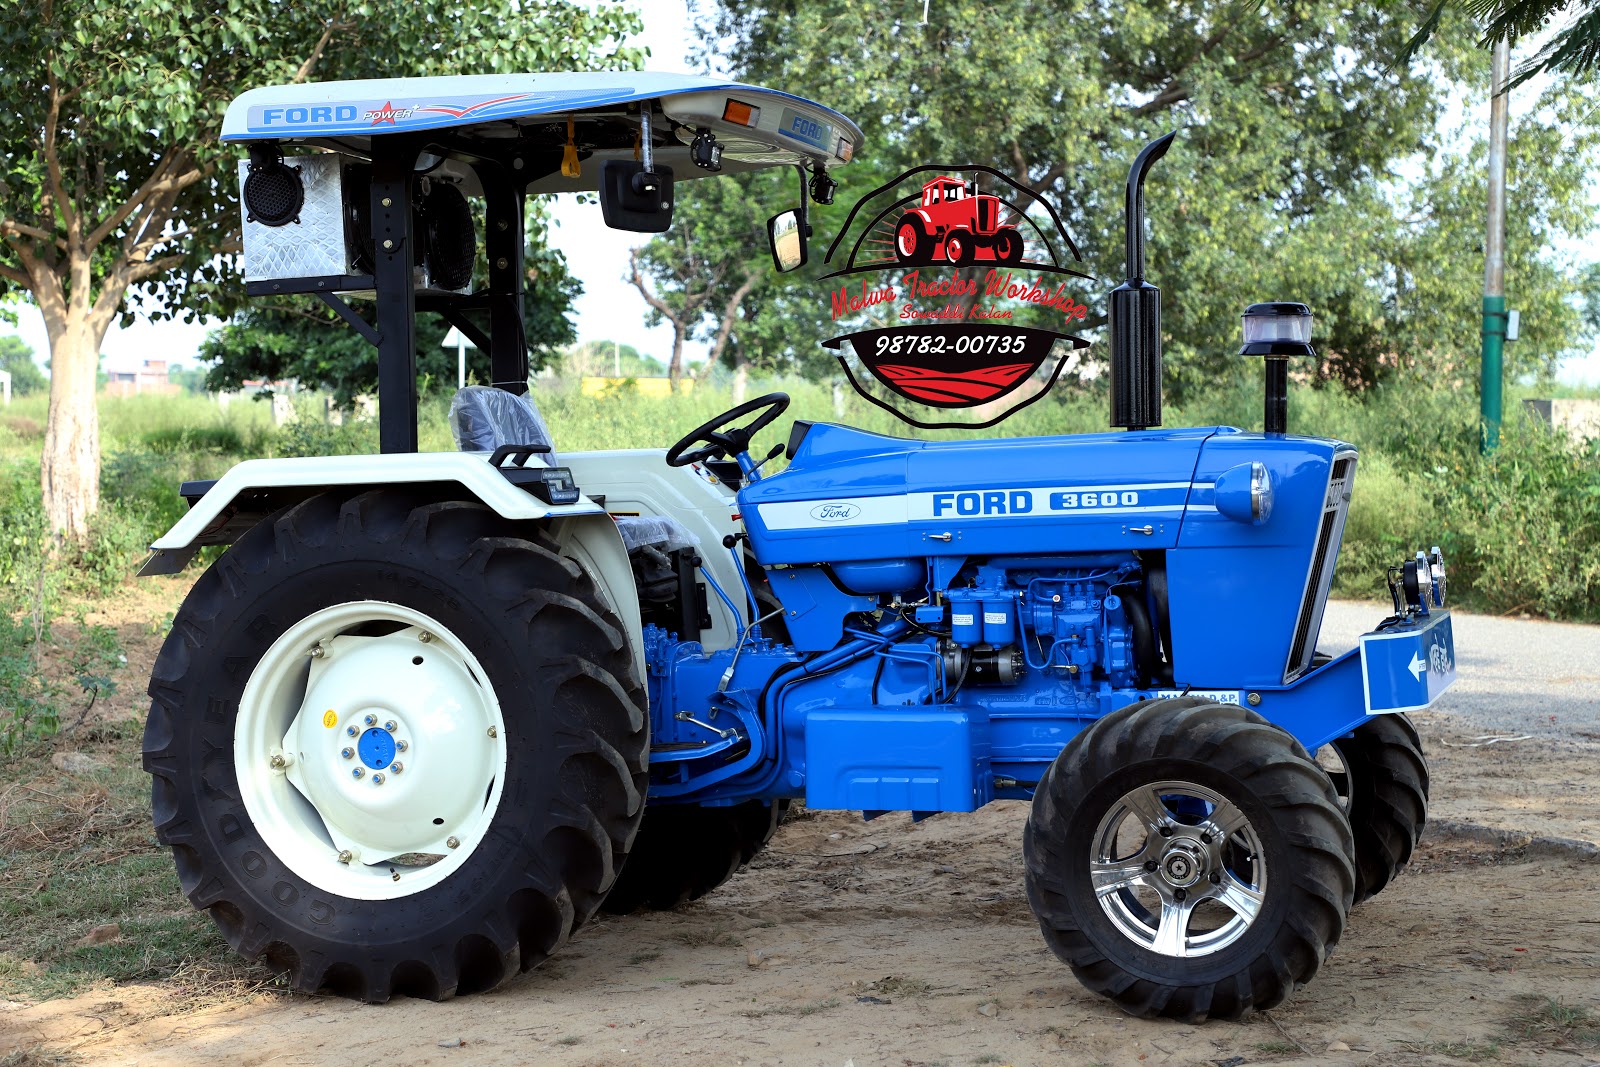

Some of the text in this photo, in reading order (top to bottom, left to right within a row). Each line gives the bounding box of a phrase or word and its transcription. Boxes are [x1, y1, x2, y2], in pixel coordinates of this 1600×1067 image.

[263, 105, 358, 124] FORD
[791, 117, 823, 140] FORD
[820, 505, 850, 519] Ford
[933, 491, 1138, 516] FORD 3600
